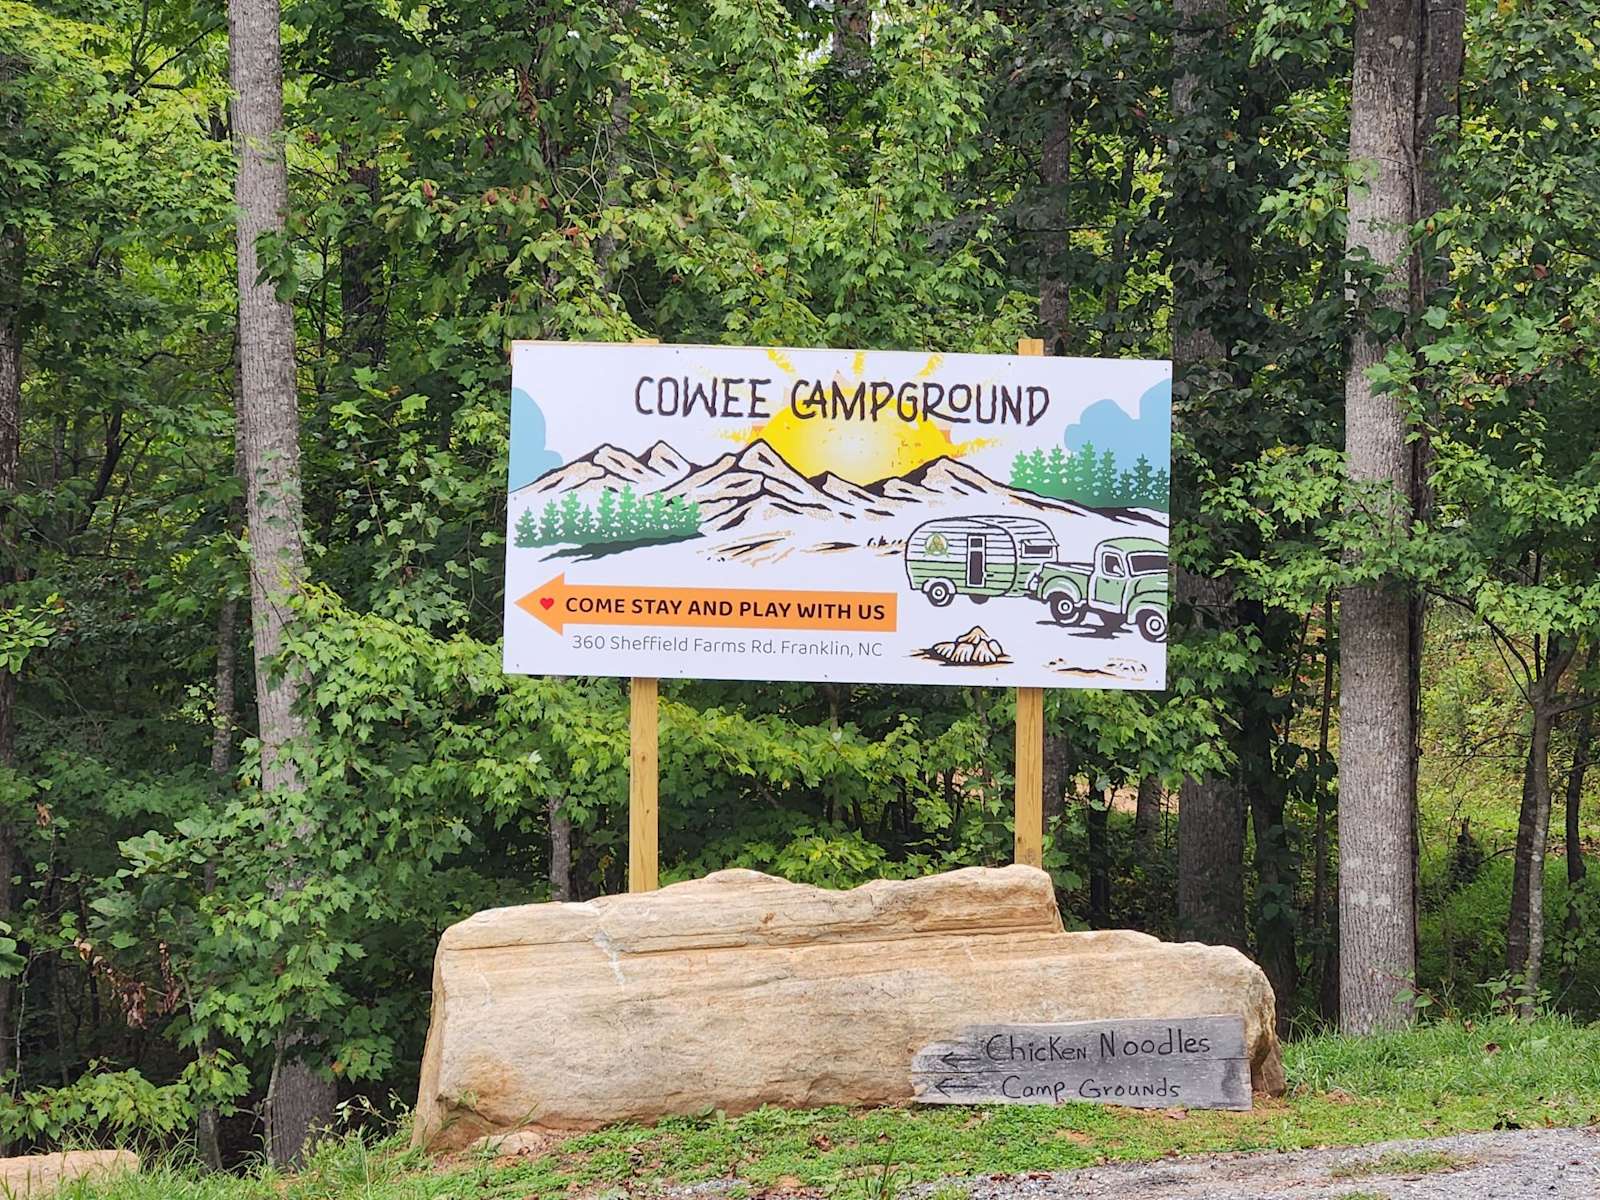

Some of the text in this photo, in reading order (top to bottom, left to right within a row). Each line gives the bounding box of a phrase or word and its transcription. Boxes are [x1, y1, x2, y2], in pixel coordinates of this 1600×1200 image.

[634, 375, 1051, 427] COWEE CAMPGROUND
[565, 597, 886, 621] COME STAY AND PLAY WITH US
[571, 634, 883, 658] 360 Sheffield Farms Rd. Franklin, NC
[1099, 1028, 1211, 1058] Noodles
[1001, 1074, 1066, 1104] Camp
